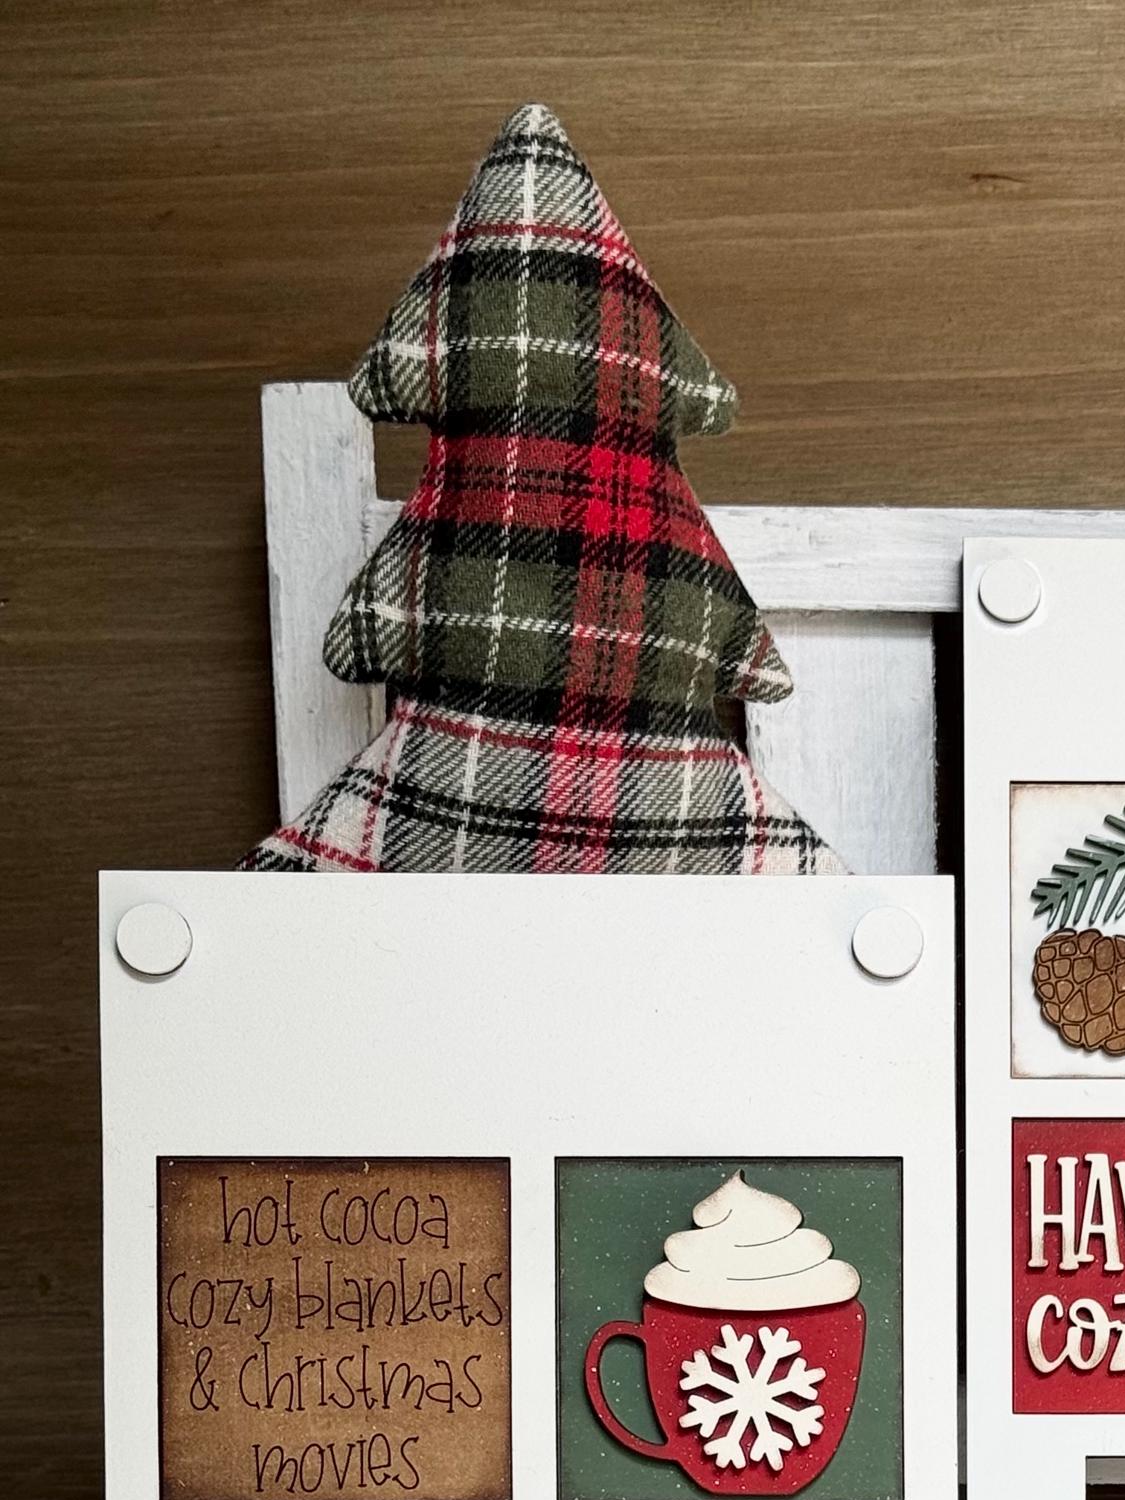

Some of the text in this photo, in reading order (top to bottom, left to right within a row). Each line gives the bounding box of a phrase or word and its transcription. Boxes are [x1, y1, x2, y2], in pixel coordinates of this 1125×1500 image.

[218, 1176, 450, 1249] hot cocoa
[167, 1256, 503, 1340] cozy blankets
[190, 1341, 482, 1413] & christmas
[252, 1433, 420, 1493] movies
